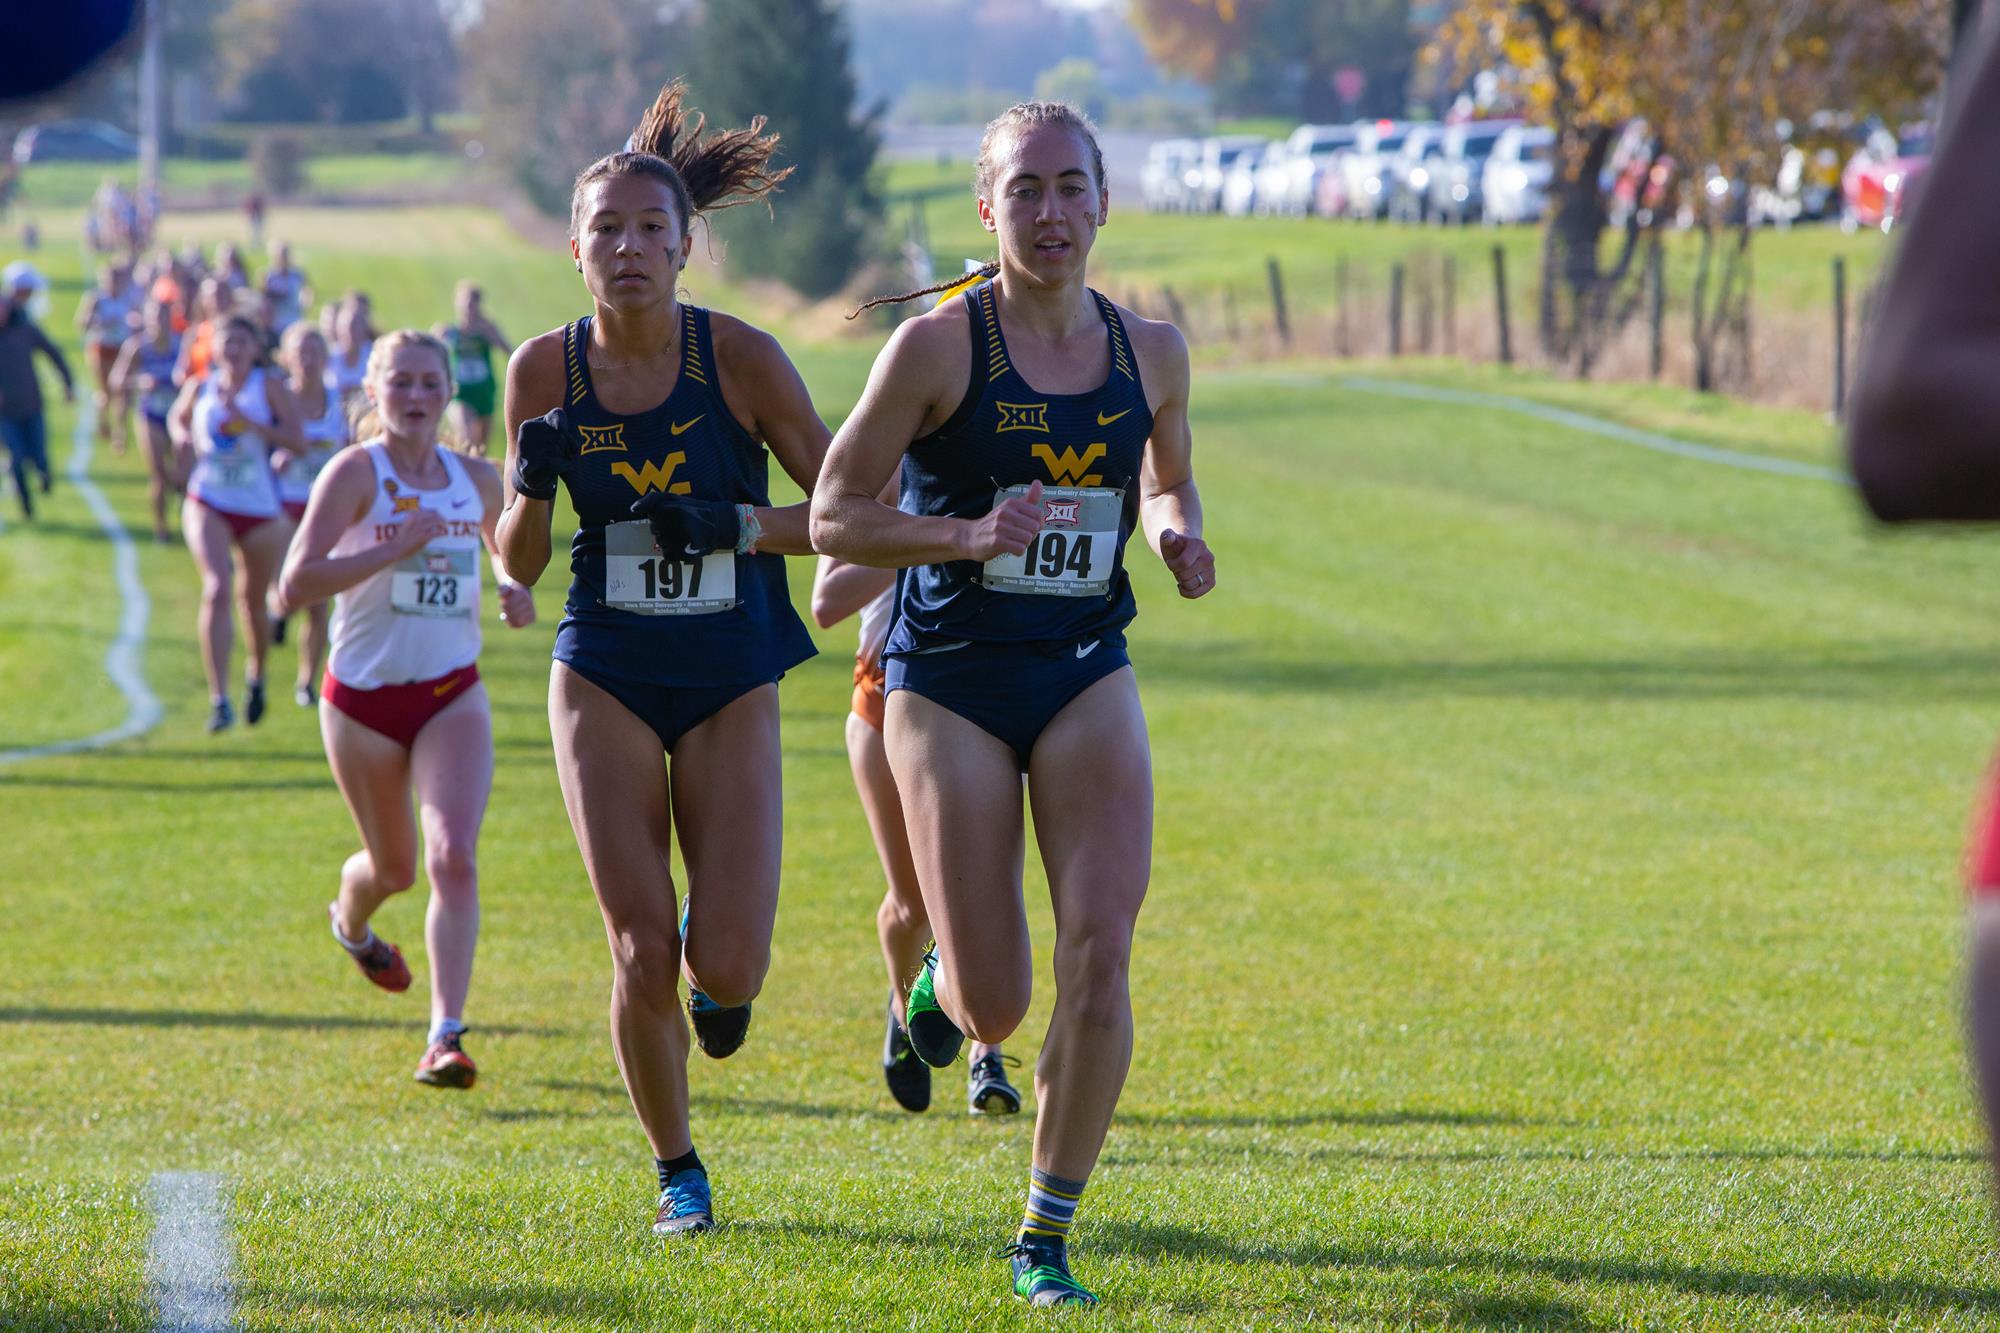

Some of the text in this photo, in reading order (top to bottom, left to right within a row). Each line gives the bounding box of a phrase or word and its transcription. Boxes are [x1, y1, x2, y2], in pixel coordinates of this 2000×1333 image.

[1024, 532, 1092, 579] 194
[415, 575, 457, 605] 123
[638, 558, 703, 599] 197
